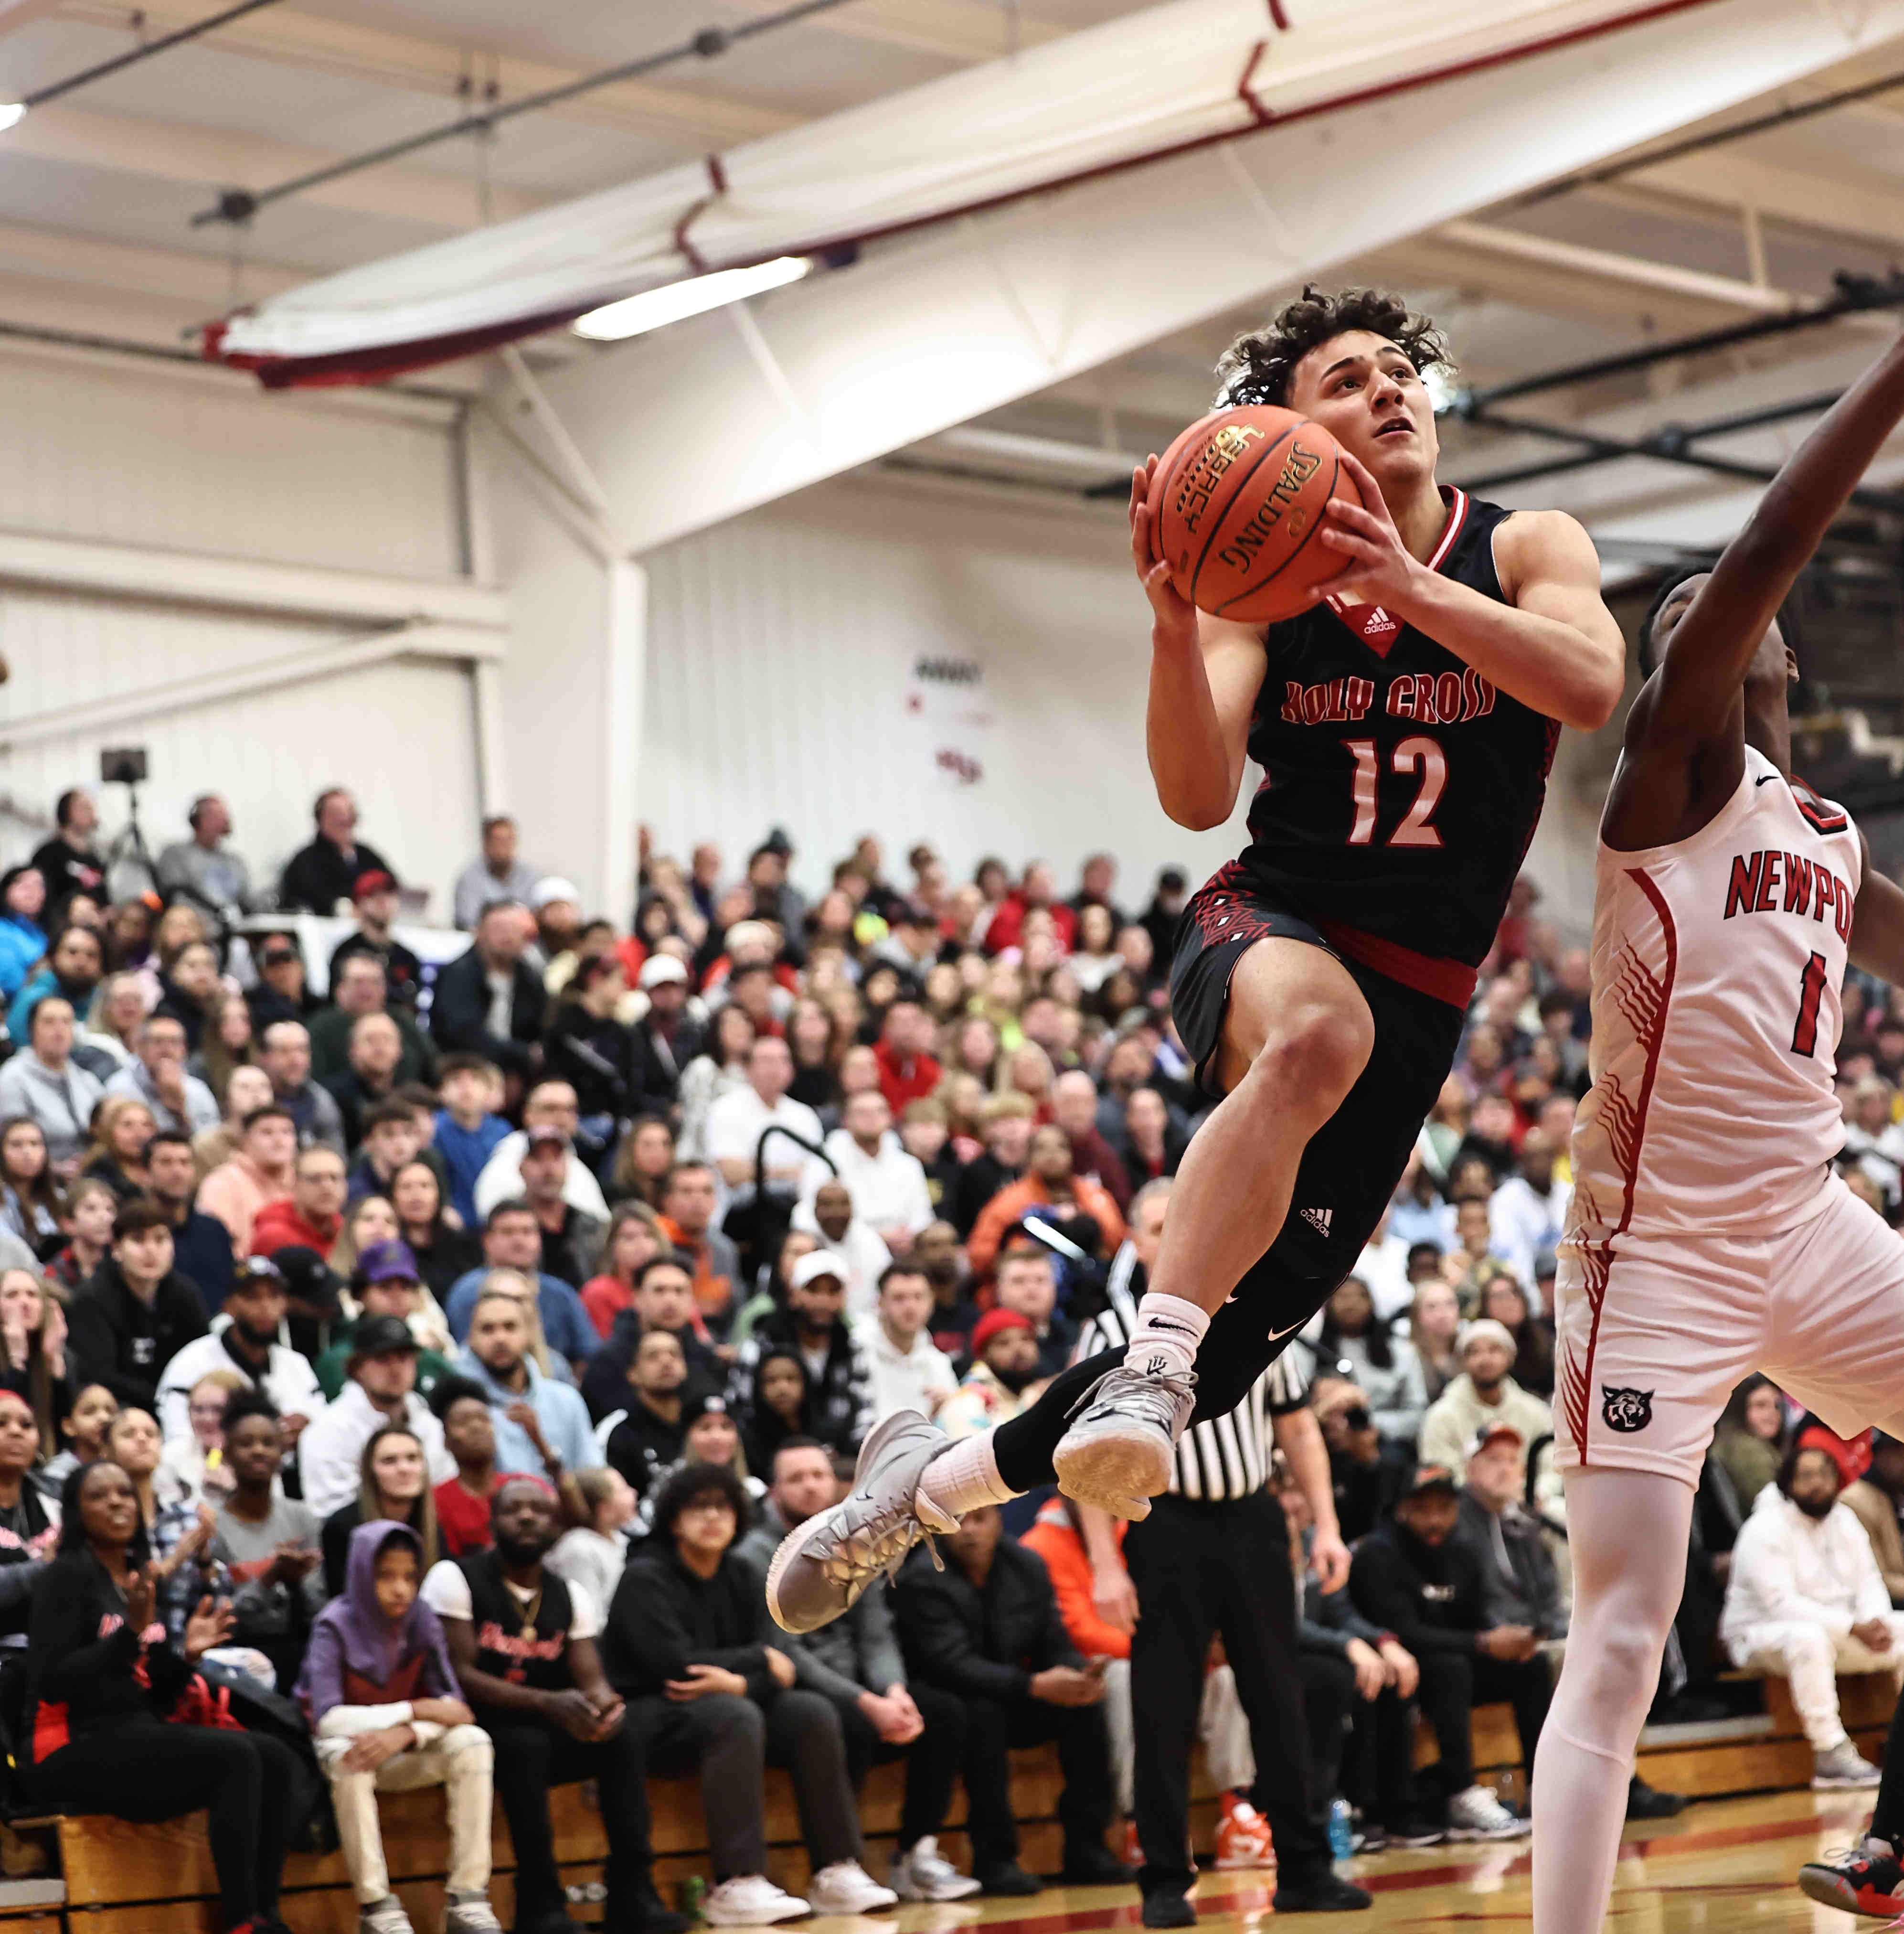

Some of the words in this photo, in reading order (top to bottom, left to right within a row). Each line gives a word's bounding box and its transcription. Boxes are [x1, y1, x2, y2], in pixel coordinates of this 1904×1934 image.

[1184, 423, 1265, 534] LEGACY
[1219, 440, 1322, 574] SPALDING
[1364, 620, 1396, 634] adidas
[1339, 734, 1447, 849] 12
[1723, 850, 1855, 949] NEWPO
[1790, 950, 1828, 1058] 1
[1300, 1208, 1330, 1238] adidas
